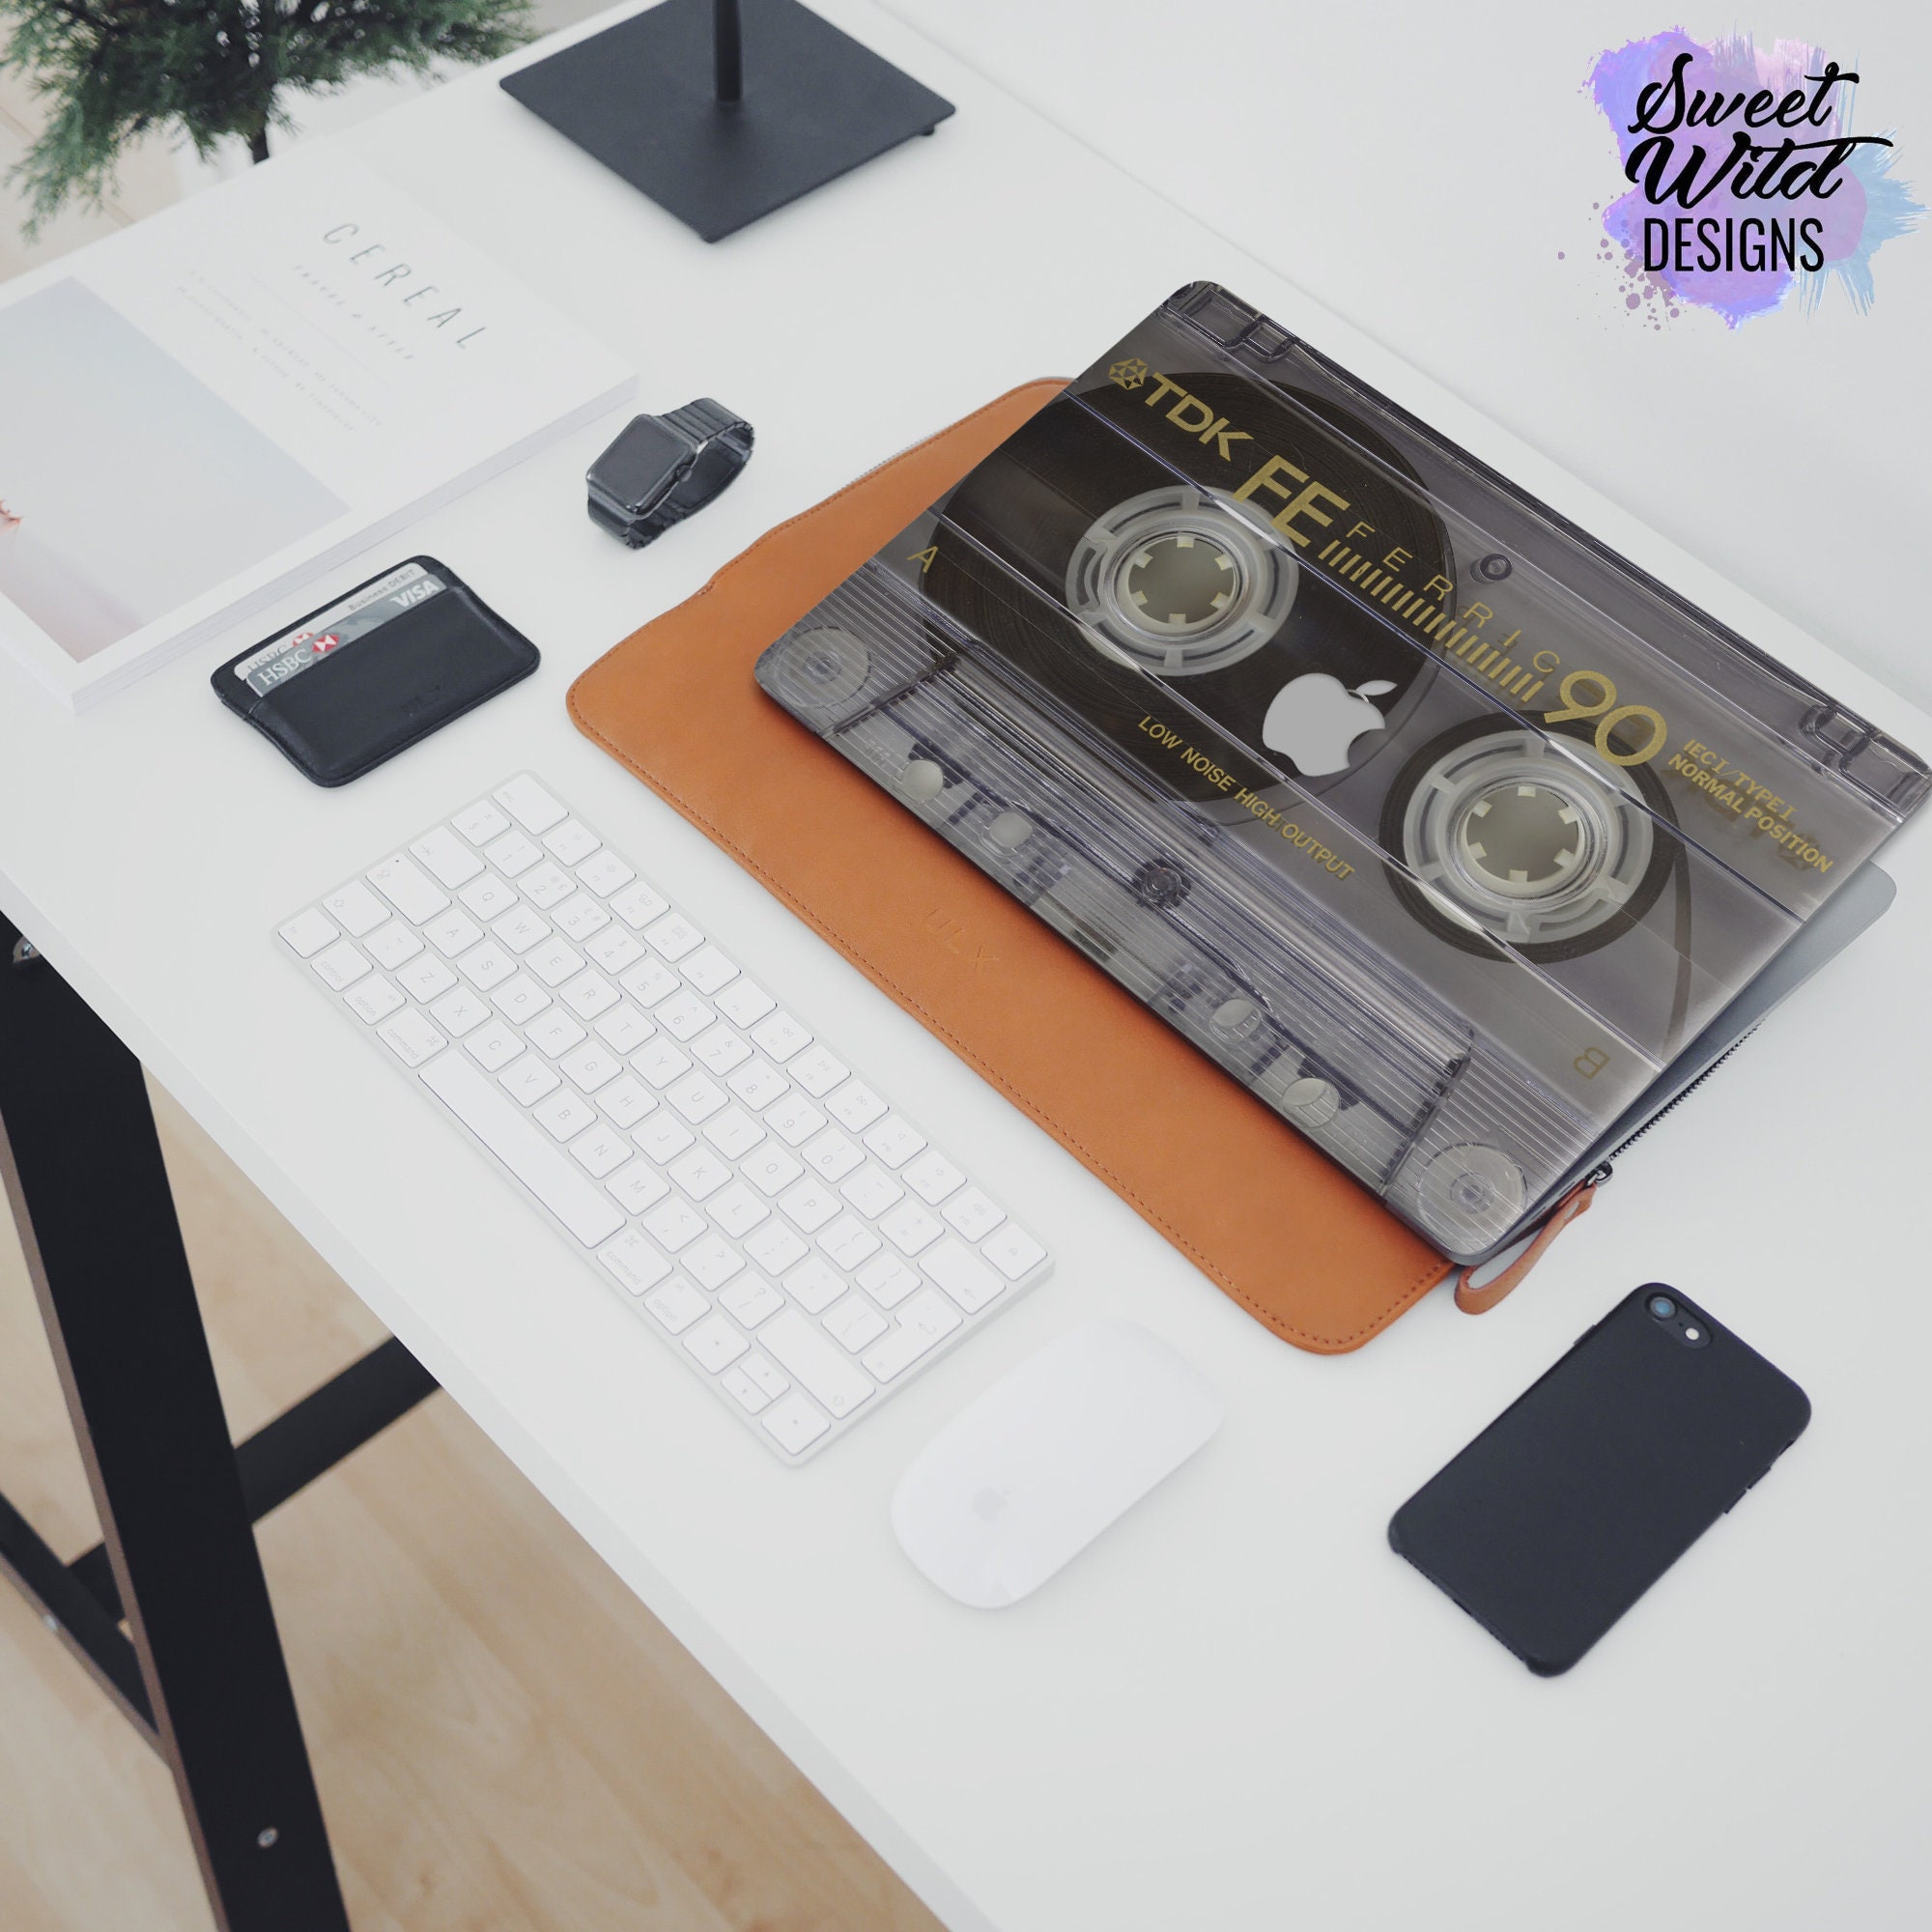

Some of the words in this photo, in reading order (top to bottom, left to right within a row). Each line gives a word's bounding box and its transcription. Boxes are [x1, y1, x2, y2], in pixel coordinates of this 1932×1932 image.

[322, 222, 487, 350] CEREAL
[1145, 371, 1253, 463] TDK
[907, 545, 939, 573] A
[348, 585, 388, 611] Business
[388, 568, 415, 587] DEBIT
[389, 580, 440, 608] VISA
[1232, 454, 1351, 549] FE
[1346, 521, 1561, 674] FERRIC
[1543, 669, 1668, 767] 90
[257, 648, 312, 687] HSBC
[1137, 716, 1183, 750] LOW
[1180, 747, 1236, 792] NOISE
[1234, 787, 1282, 828] HIGH
[1281, 823, 1356, 880] OUTPUT
[1668, 753, 1746, 813] NORMAL
[1744, 806, 1833, 873] POSITION
[533, 884, 548, 895] 2
[481, 891, 495, 902] Q
[567, 916, 581, 926] 3
[445, 928, 460, 938] A
[514, 921, 531, 935] W
[603, 950, 615, 958] 4
[480, 960, 495, 971] S
[549, 955, 562, 967] E
[320, 959, 344, 982] control
[419, 972, 434, 983] Z
[637, 980, 650, 991] 5
[513, 992, 527, 1004] D
[582, 988, 596, 1001] R
[355, 995, 378, 1016] option
[452, 1005, 469, 1018] X
[672, 1014, 685, 1025] 6
[549, 1027, 563, 1036] F
[619, 1021, 633, 1033] T
[488, 1039, 502, 1051] C
[708, 1048, 723, 1058] 7
[584, 1061, 598, 1072] G
[656, 1056, 669, 1066] Y
[1573, 1046, 1610, 1080] B
[525, 1073, 539, 1084] V
[745, 1083, 758, 1094] 8
[619, 1094, 635, 1108] H
[691, 1091, 705, 1103] U
[556, 1108, 572, 1121] B
[782, 1119, 796, 1129] 9
[593, 1144, 610, 1157] N
[692, 1166, 708, 1179] K
[629, 1179, 646, 1194] M
[803, 1198, 817, 1208] P
